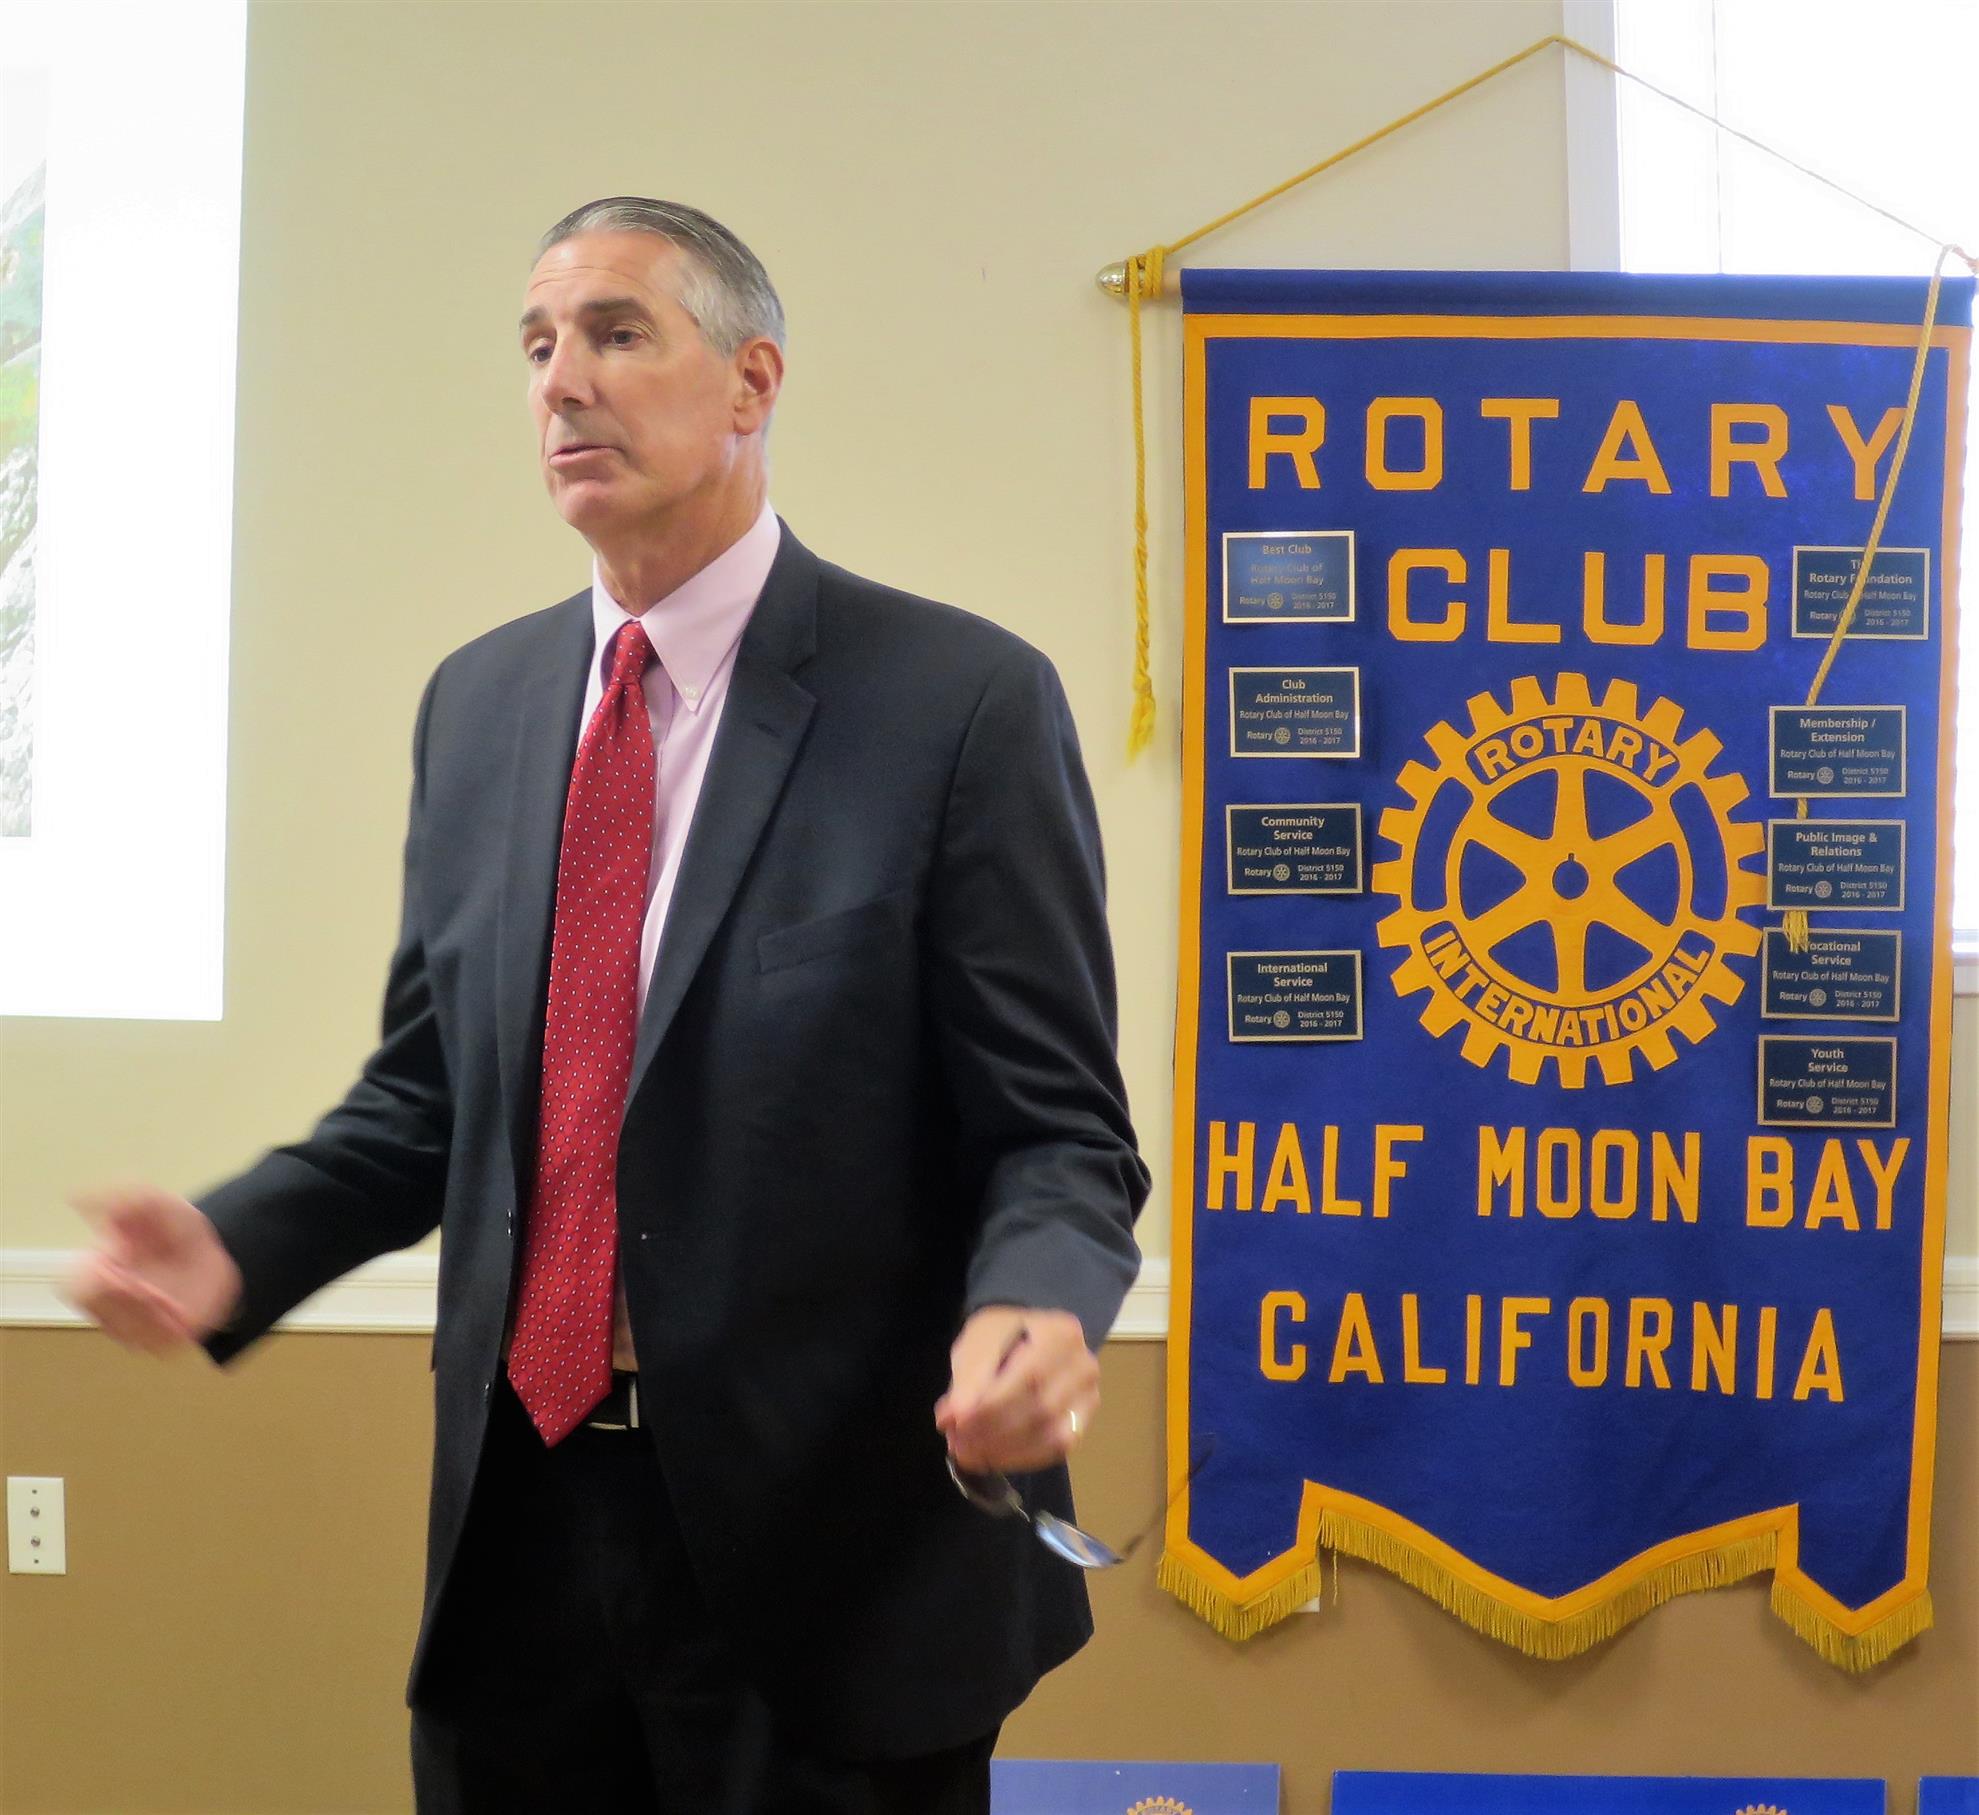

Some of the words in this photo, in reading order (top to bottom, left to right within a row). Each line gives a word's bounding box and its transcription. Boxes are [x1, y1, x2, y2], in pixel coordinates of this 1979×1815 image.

[1248, 396, 1909, 500] ROTARY
[1263, 545, 1284, 554] Best
[1288, 544, 1312, 554] Club
[1287, 563, 1309, 572] Club
[1311, 563, 1322, 571] of
[1306, 576, 1323, 585] Bay
[1809, 573, 1847, 585] Rotary
[1850, 574, 1912, 584] Fndation
[1388, 548, 1770, 651] CLUB
[1804, 590, 1830, 600] Rotary
[1832, 591, 1849, 599] Club
[1240, 597, 1265, 606] Rotary
[1810, 611, 1837, 621] Rotary
[1282, 680, 1306, 689] Club
[1255, 693, 1333, 703] Administration
[1240, 710, 1264, 720] Rotary
[1266, 710, 1282, 719] Club
[1285, 710, 1292, 719] of
[1294, 710, 1309, 719] Half
[1311, 710, 1333, 719] Moon
[1335, 711, 1349, 720] Bay
[1800, 718, 1869, 730] Membership
[1247, 731, 1274, 741] Rotary
[1811, 732, 1865, 742] Extension
[1474, 717, 1678, 781] ROTARY
[1780, 749, 1807, 760] Rotary
[1808, 750, 1826, 758] Club
[1828, 749, 1837, 758] of
[1839, 750, 1854, 758] Half
[1857, 750, 1880, 758] Moon
[1881, 750, 1896, 759] Bay
[1787, 771, 1816, 780] Rotary
[1261, 816, 1325, 828] Community
[1273, 830, 1313, 840] Service
[1795, 832, 1829, 842] Public
[1832, 832, 1865, 844] Image
[1869, 832, 1877, 842] &
[1237, 847, 1262, 857] Rotary
[1264, 847, 1282, 855] Club
[1284, 847, 1292, 855] of
[1294, 847, 1310, 856] Half
[1312, 847, 1335, 856] Moon
[1336, 847, 1350, 856] Bay
[1811, 846, 1862, 856] Relations
[1244, 868, 1272, 877] Rotary
[1778, 863, 1805, 873] Rotary
[1807, 863, 1825, 872] Club
[1826, 863, 1835, 872] of
[1837, 864, 1853, 872] Half
[1855, 864, 1879, 872] Moon
[1880, 864, 1895, 874] Bay
[1785, 884, 1814, 894] Rotary
[1807, 941, 1861, 952] ocational
[1811, 955, 1852, 966] Service
[1258, 962, 1328, 973] International
[1274, 976, 1313, 987] Service
[1773, 971, 1799, 981] Rotary
[1801, 971, 1819, 980] Club
[1820, 971, 1830, 980] of
[1831, 972, 1848, 981] Half
[1850, 972, 1873, 981] Moon
[1875, 973, 1889, 984] Bay
[1424, 929, 1711, 1047] INTERNATIONAL
[1237, 994, 1263, 1004] Rotary
[1265, 994, 1282, 1002] Club
[1284, 993, 1292, 1002] of
[1294, 993, 1310, 1002] Half
[1311, 993, 1335, 1002] Moon
[1336, 993, 1350, 1004] Bay
[1780, 992, 1808, 1002] Rotary
[1835, 990, 1861, 998] District
[1245, 1015, 1272, 1024] Rotary
[1811, 1048, 1844, 1059] Youth
[1808, 1062, 1848, 1073] Service
[1769, 1079, 1796, 1089] Rotary
[1798, 1079, 1816, 1088] Club
[1818, 1079, 1827, 1088] of
[1828, 1079, 1844, 1088] Half
[1847, 1079, 1869, 1089] Moon
[1871, 1080, 1886, 1090] Bay
[1776, 1099, 1805, 1109] Rotary
[1206, 1120, 1425, 1219] HALF
[1477, 1125, 1701, 1224] MOON
[1745, 1135, 1911, 1232] BAY
[1259, 1290, 1845, 1403] CALIFORNIA
